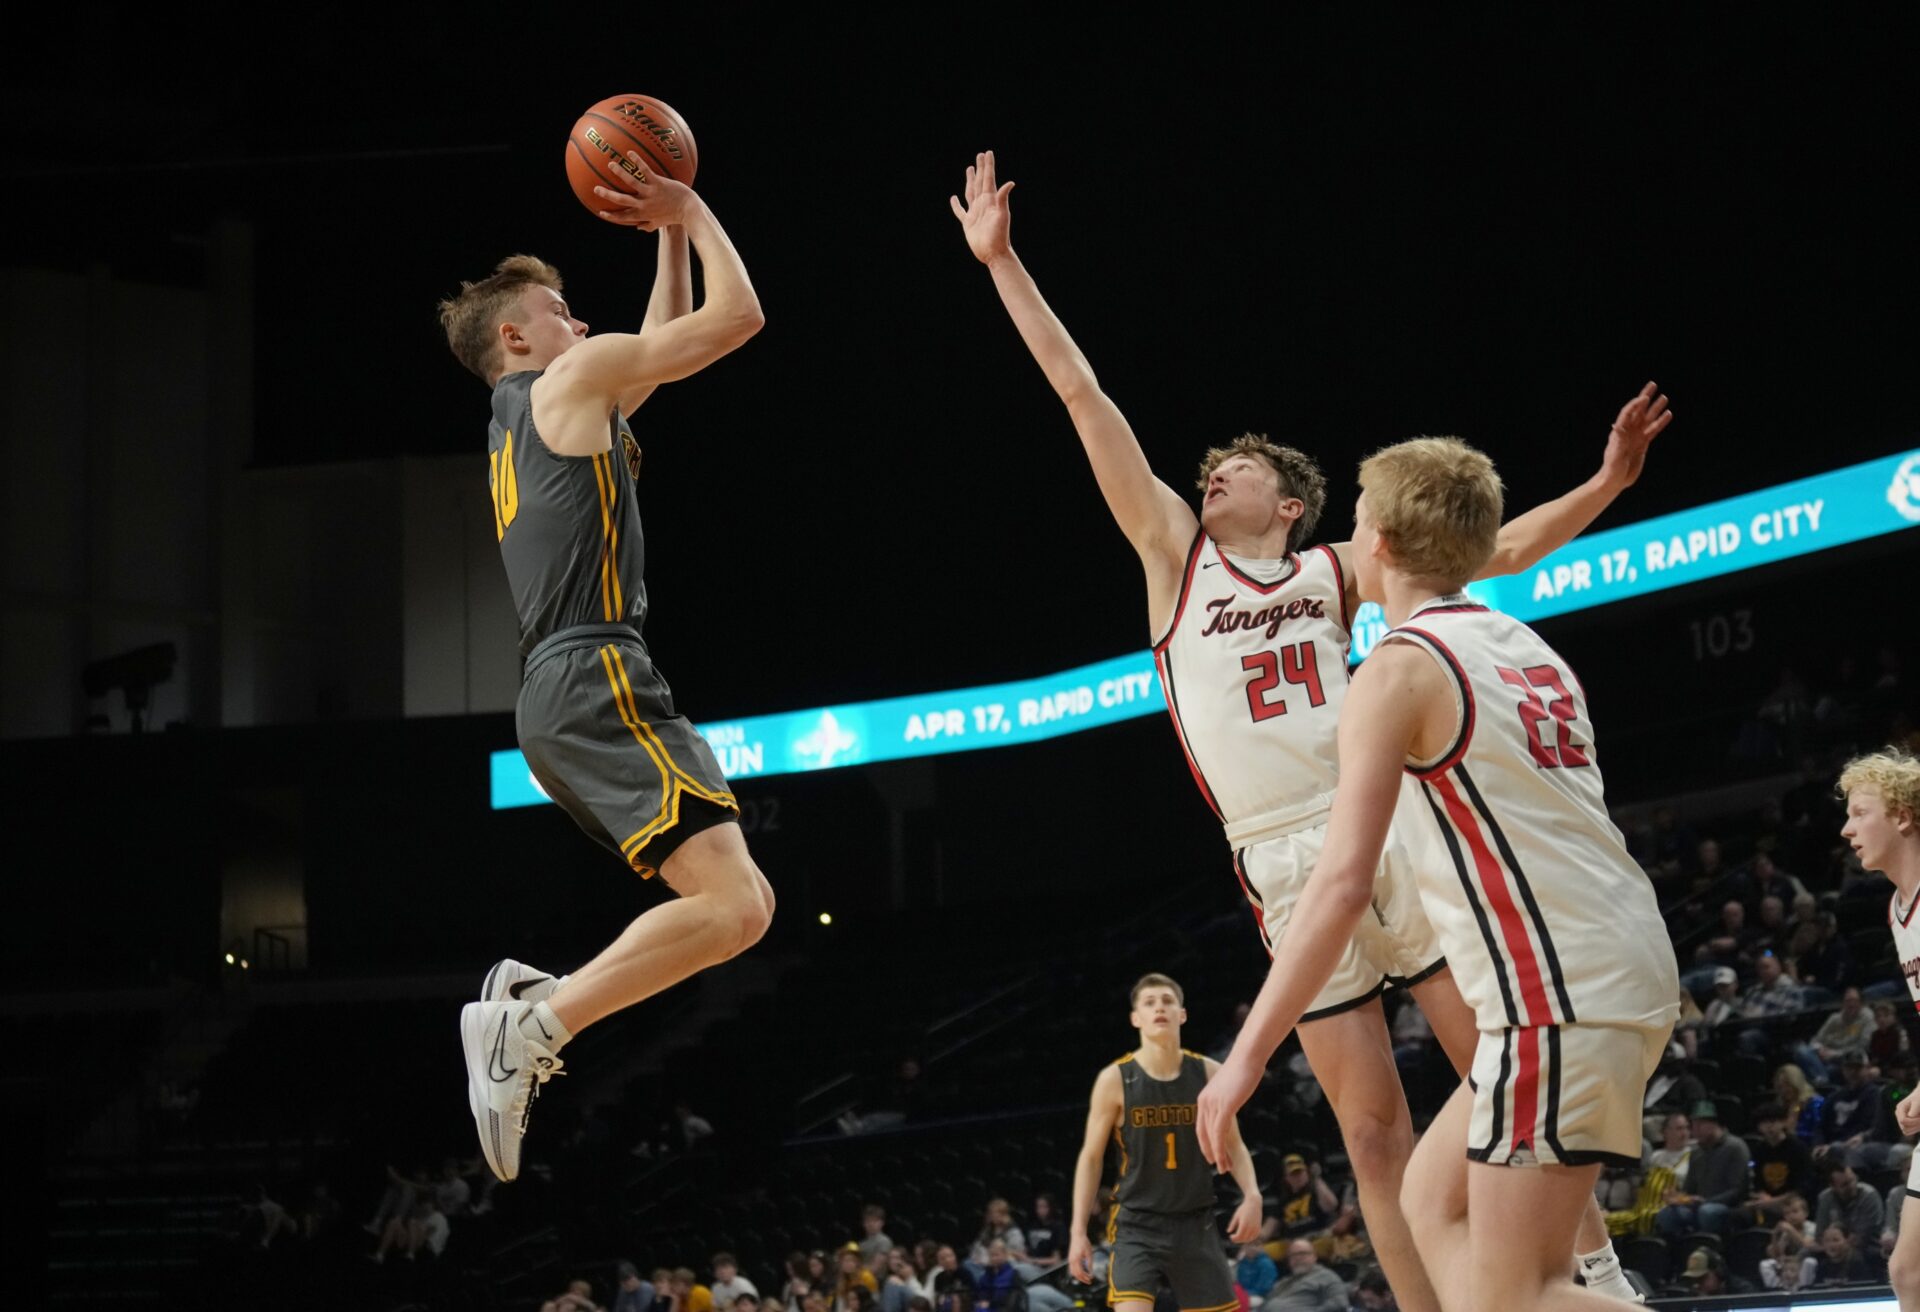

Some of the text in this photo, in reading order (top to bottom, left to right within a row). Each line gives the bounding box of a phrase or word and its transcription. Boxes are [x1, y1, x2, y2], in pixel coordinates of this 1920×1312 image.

[613, 101, 683, 161] Baden
[1533, 499, 1825, 602] APR 17, RAPID CITY
[1201, 593, 1325, 640] Tanagers
[1690, 609, 1755, 661] 103
[904, 671, 1153, 742] APR 17, RAPID CITY
[1241, 640, 1327, 723] 24
[1494, 664, 1590, 769] 22
[1165, 1132, 1177, 1169] 1
